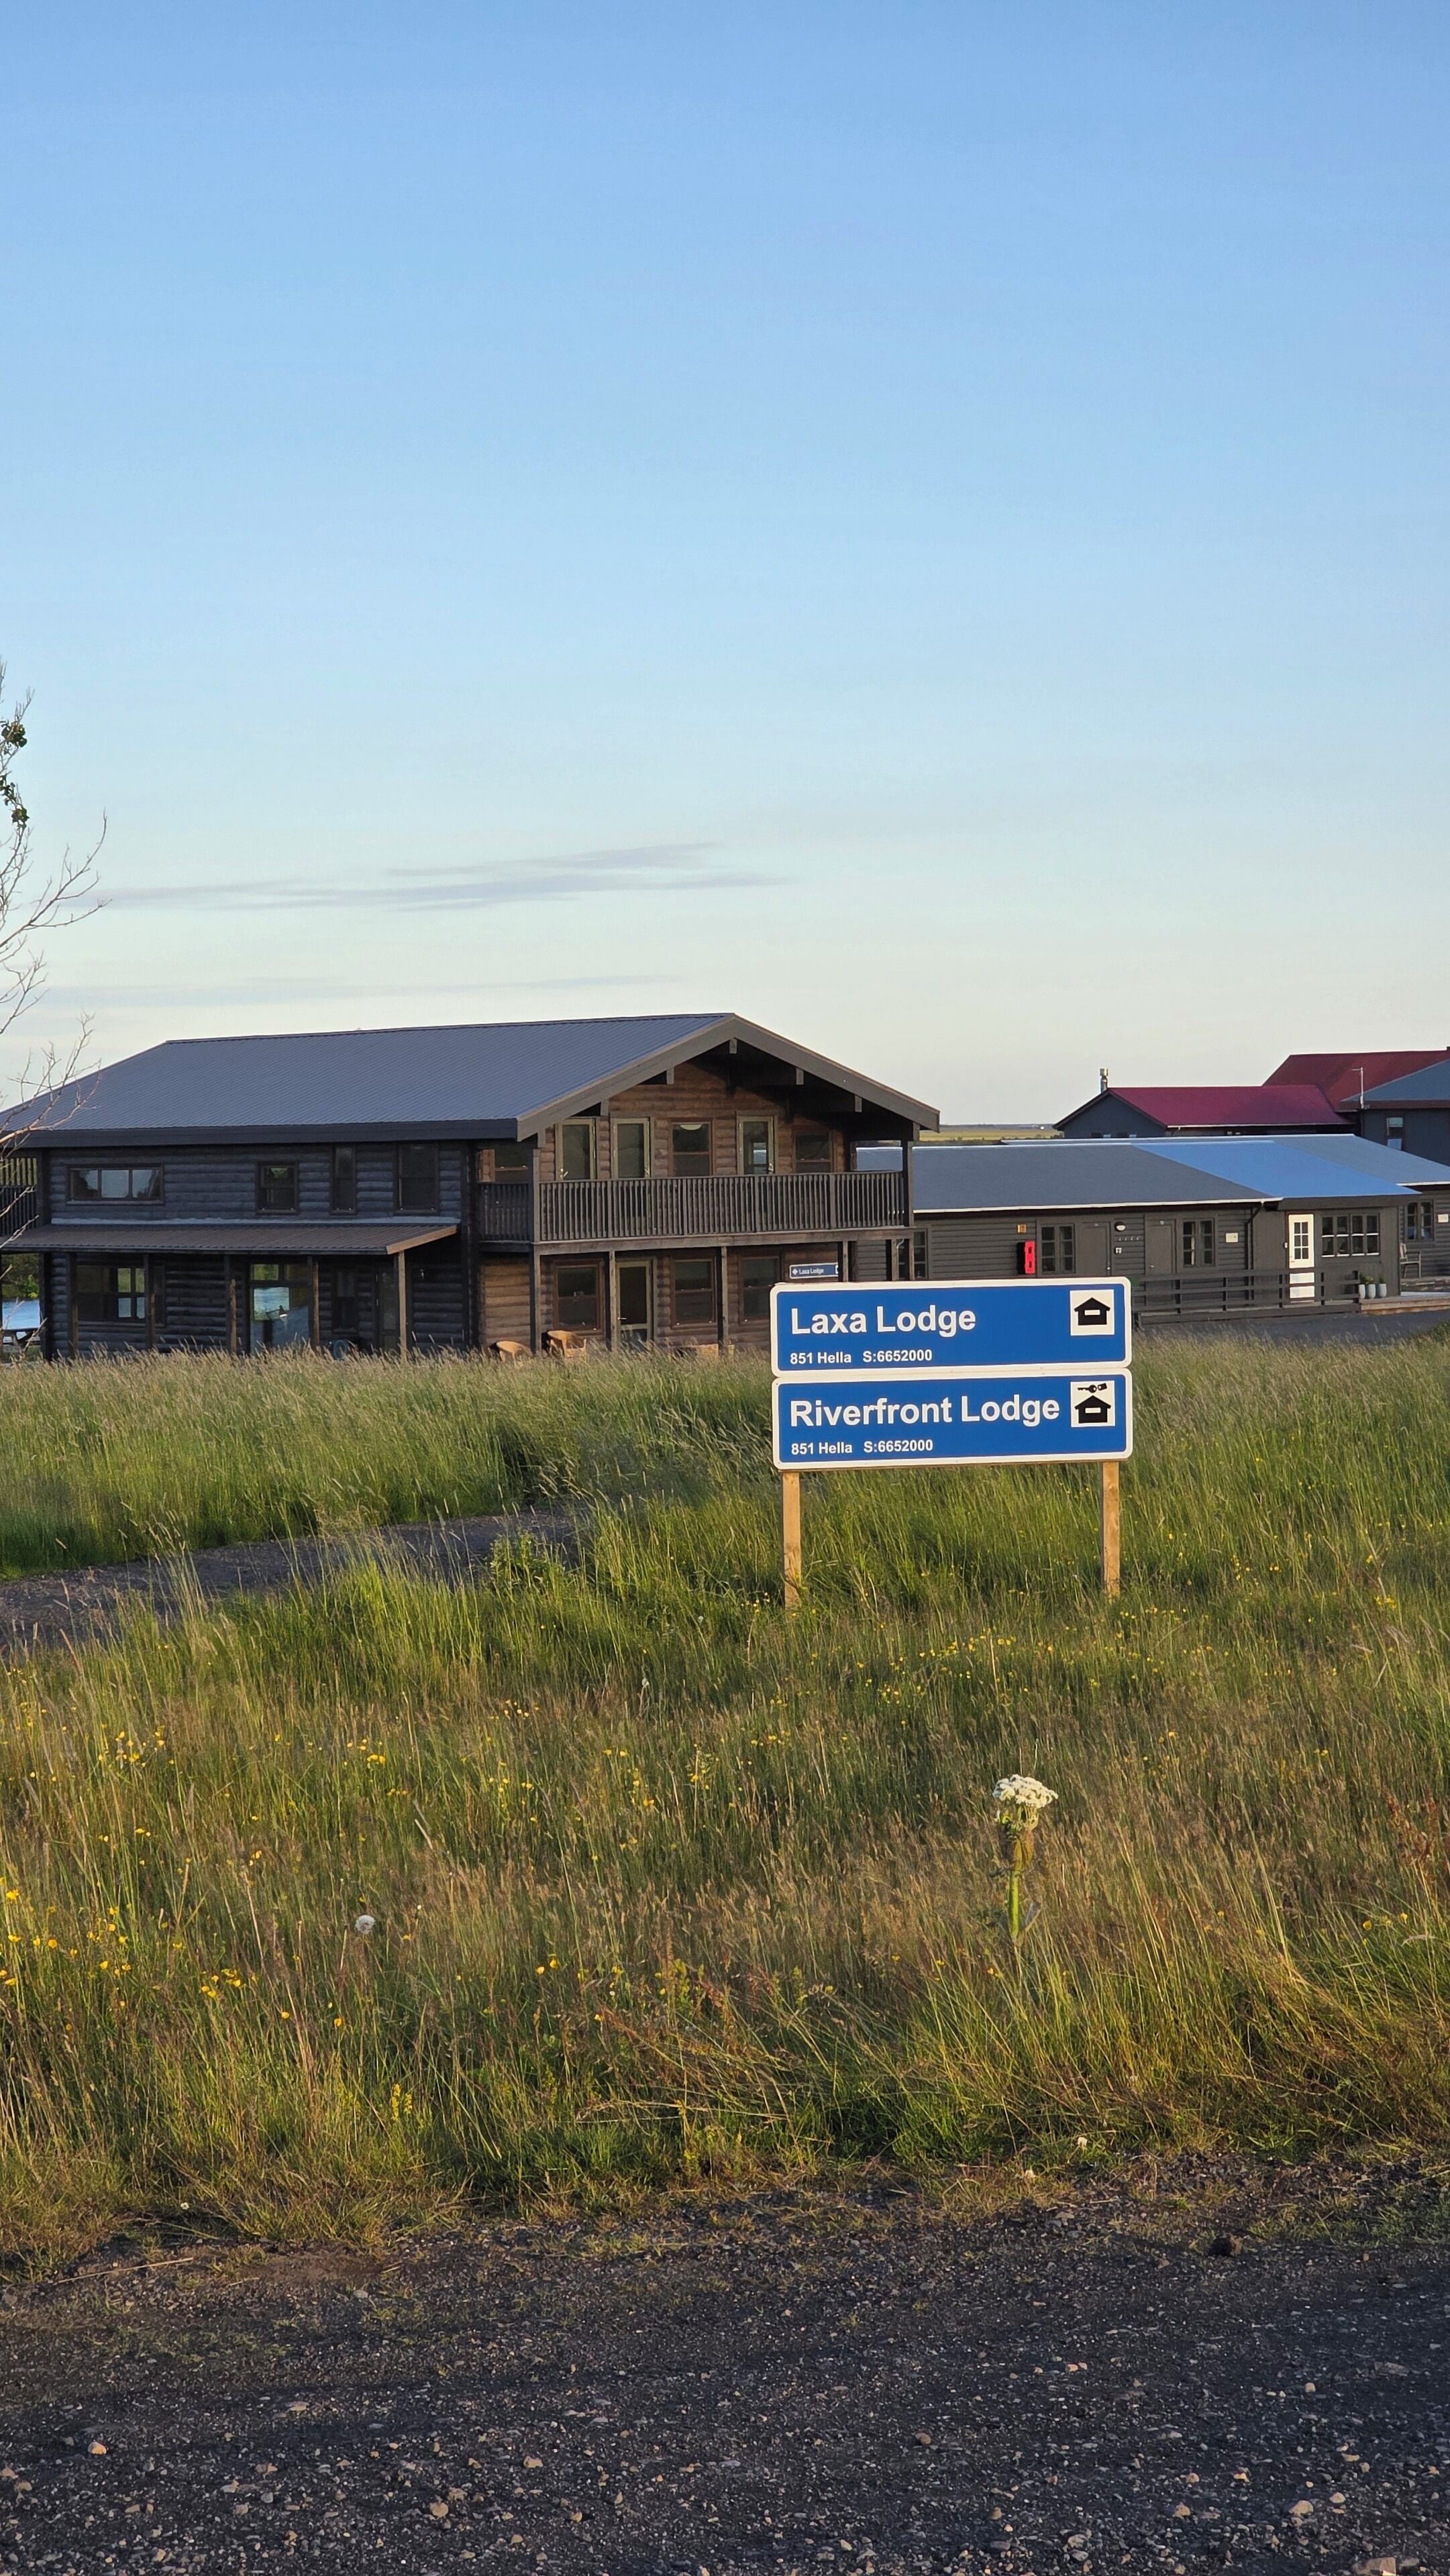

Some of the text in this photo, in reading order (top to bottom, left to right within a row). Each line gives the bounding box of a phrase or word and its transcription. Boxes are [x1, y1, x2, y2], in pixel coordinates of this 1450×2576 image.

[791, 1305, 976, 1337] Laxa Lodge
[790, 1349, 933, 1364] 851 Hella S:6652000
[790, 1395, 1060, 1427] Riverfront Lodge
[791, 1439, 933, 1455] 851 Hella S:6652000
